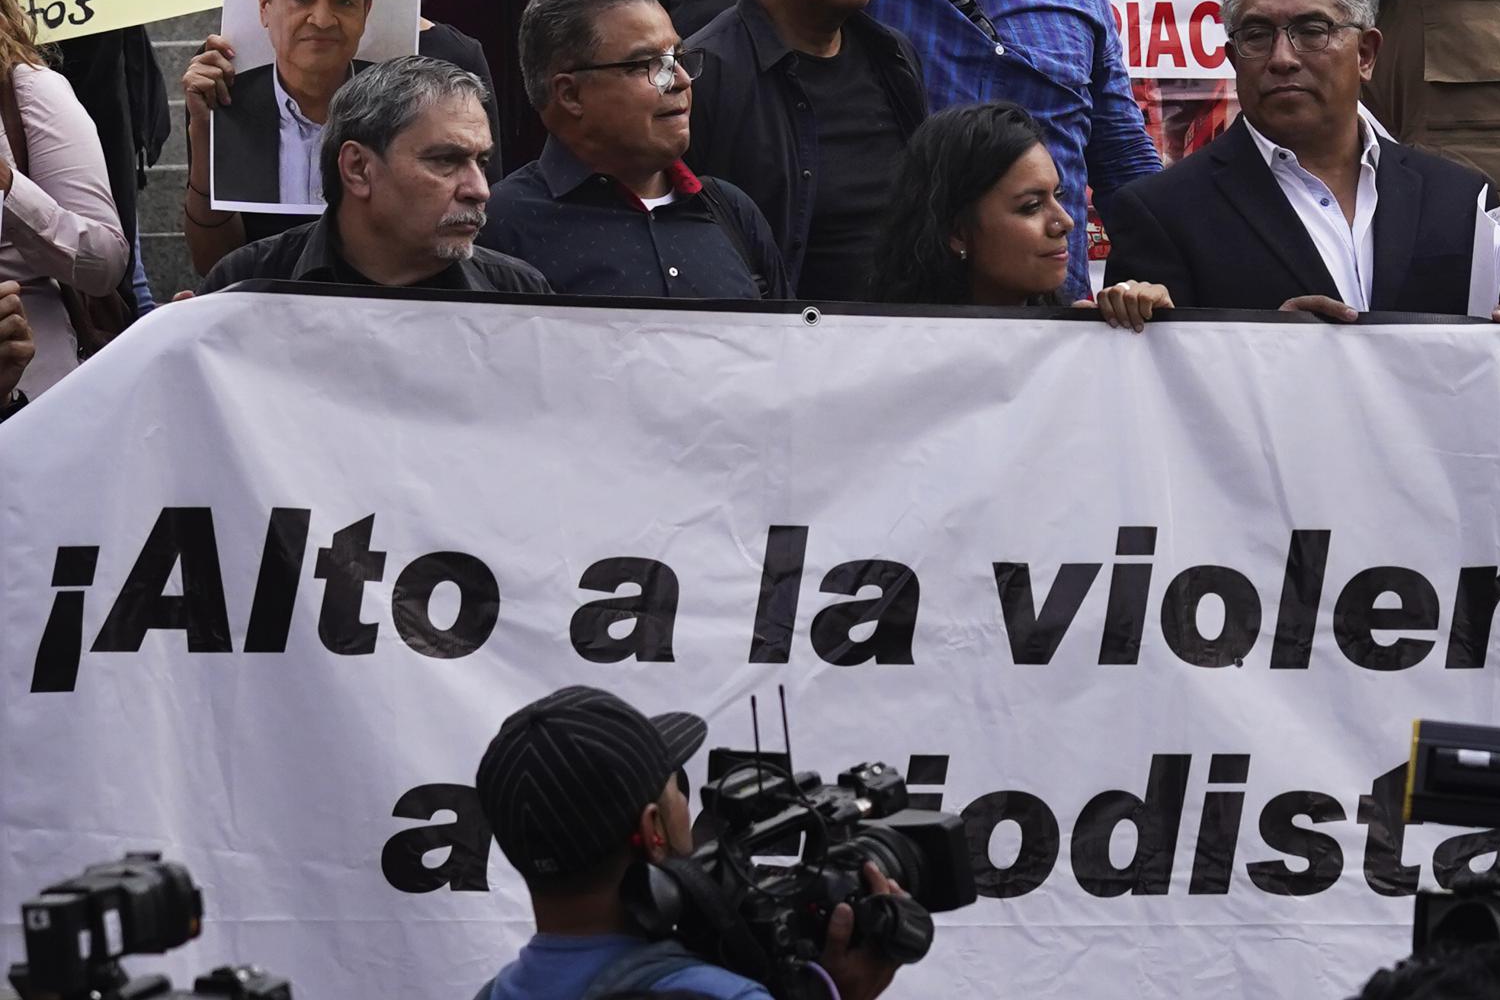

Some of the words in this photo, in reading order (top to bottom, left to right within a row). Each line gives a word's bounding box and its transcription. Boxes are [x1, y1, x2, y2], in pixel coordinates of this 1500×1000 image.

[29, 505, 501, 694] ¡Alto
[568, 554, 681, 664] a
[747, 524, 921, 667] la
[380, 782, 494, 893] a
